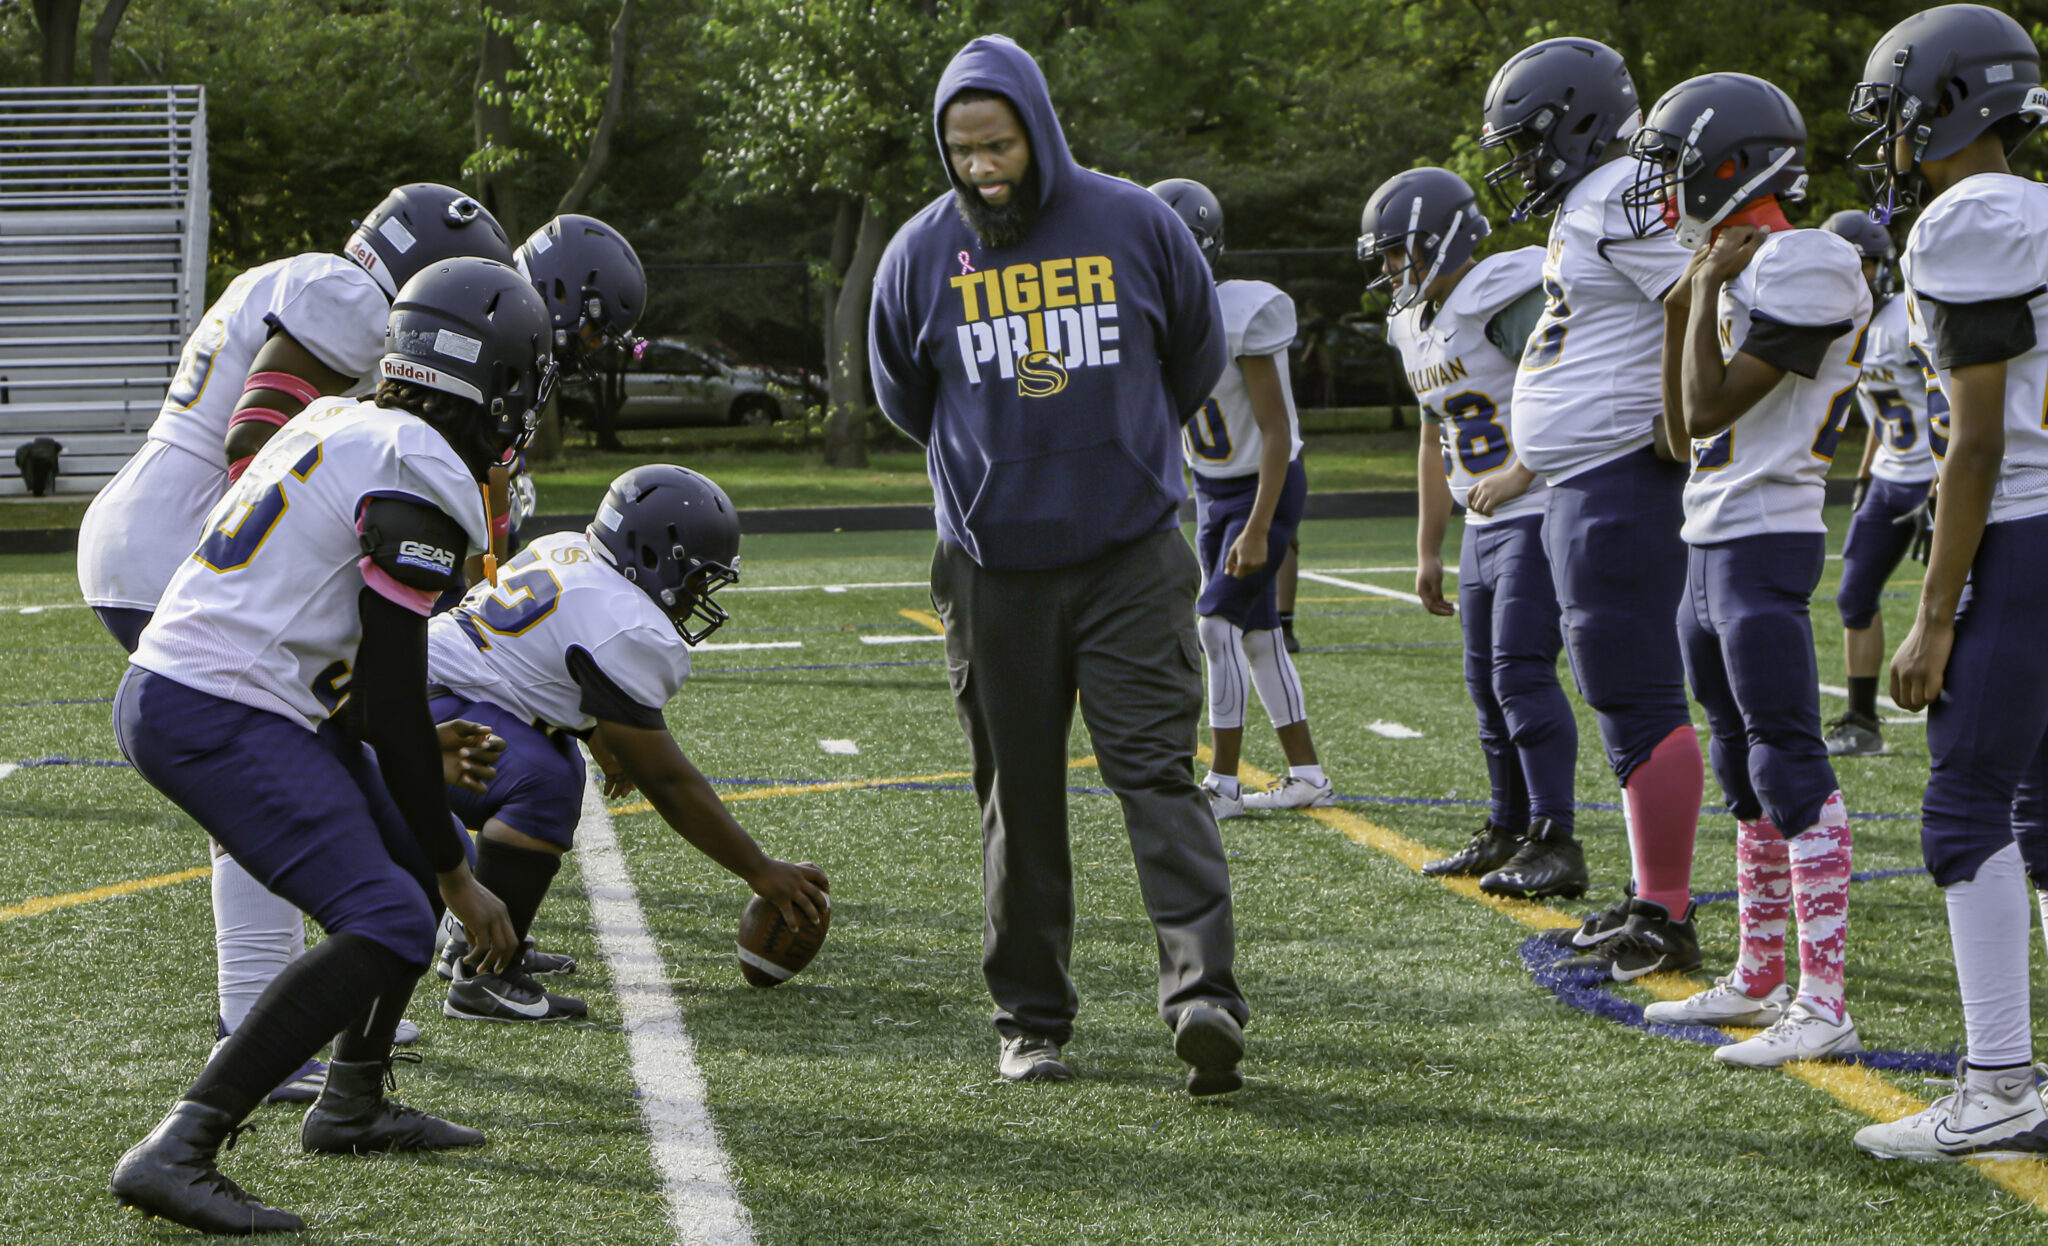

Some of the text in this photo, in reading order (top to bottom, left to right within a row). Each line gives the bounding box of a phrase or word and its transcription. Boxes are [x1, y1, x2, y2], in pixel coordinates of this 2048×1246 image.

[2032, 92, 2048, 107] sch
[950, 255, 1116, 322] TIGER
[384, 361, 437, 384] Riddell
[956, 303, 1120, 384] PRIDE
[1182, 396, 1234, 462] 0
[1868, 387, 1919, 454] 5
[192, 427, 324, 575] 6
[399, 540, 456, 568] GEAR
